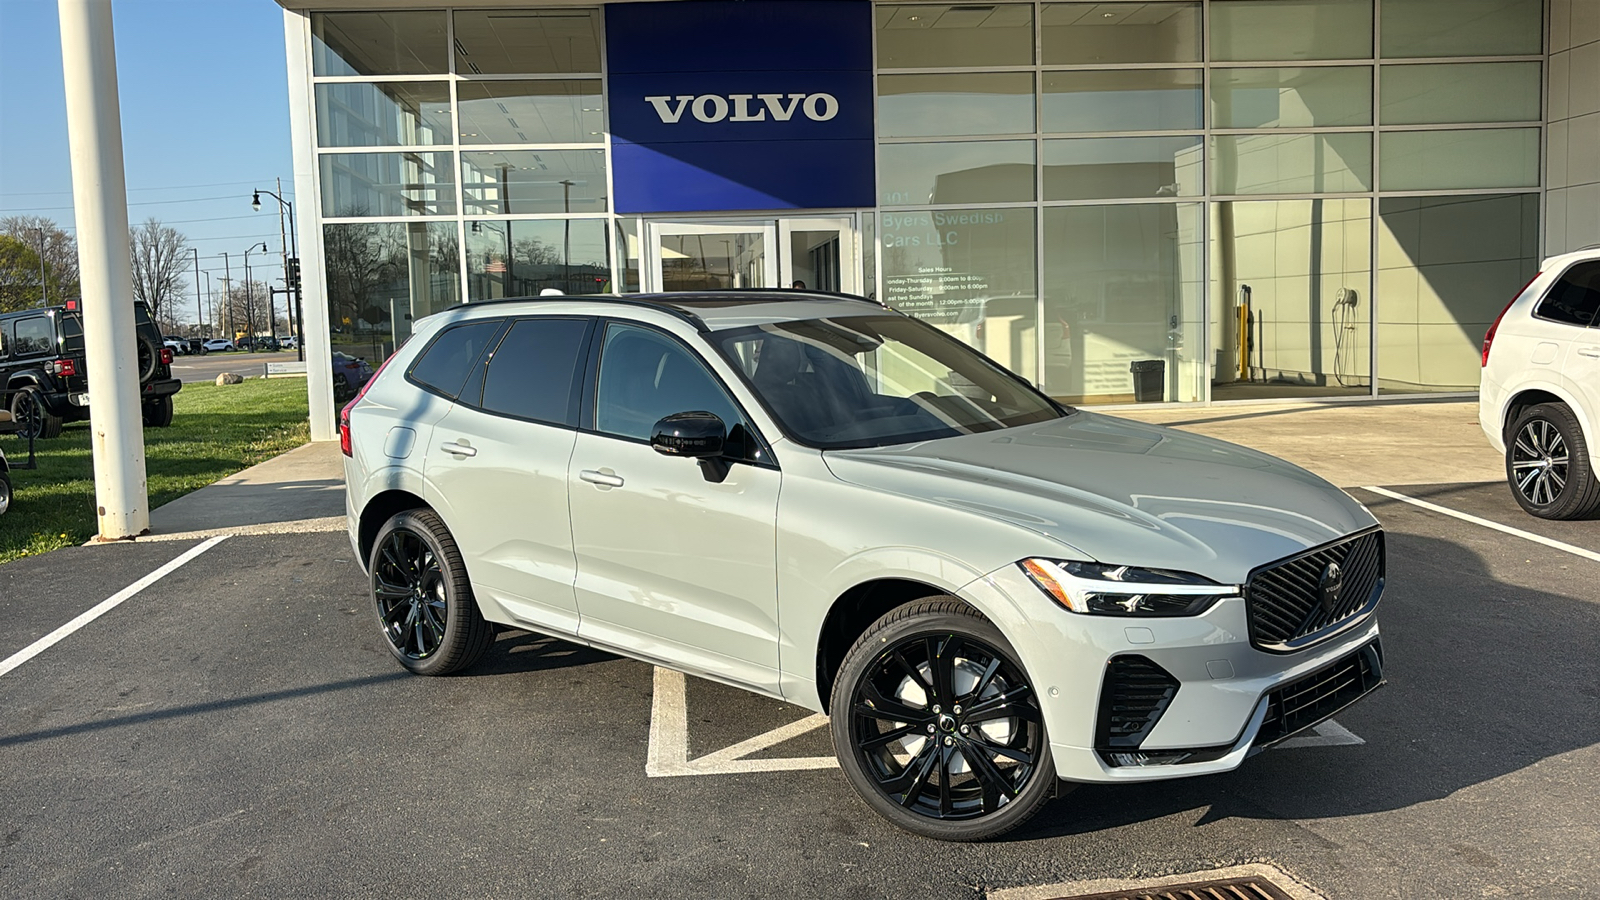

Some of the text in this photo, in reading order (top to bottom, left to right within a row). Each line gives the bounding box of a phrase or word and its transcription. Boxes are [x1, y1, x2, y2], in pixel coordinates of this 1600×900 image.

[644, 93, 839, 123] VOLVO
[883, 211, 1003, 230] Byers Swedish
[883, 231, 958, 248] Cars LLC
[887, 277, 933, 285] onday-Thursday
[888, 285, 933, 293] Friday-Saturday
